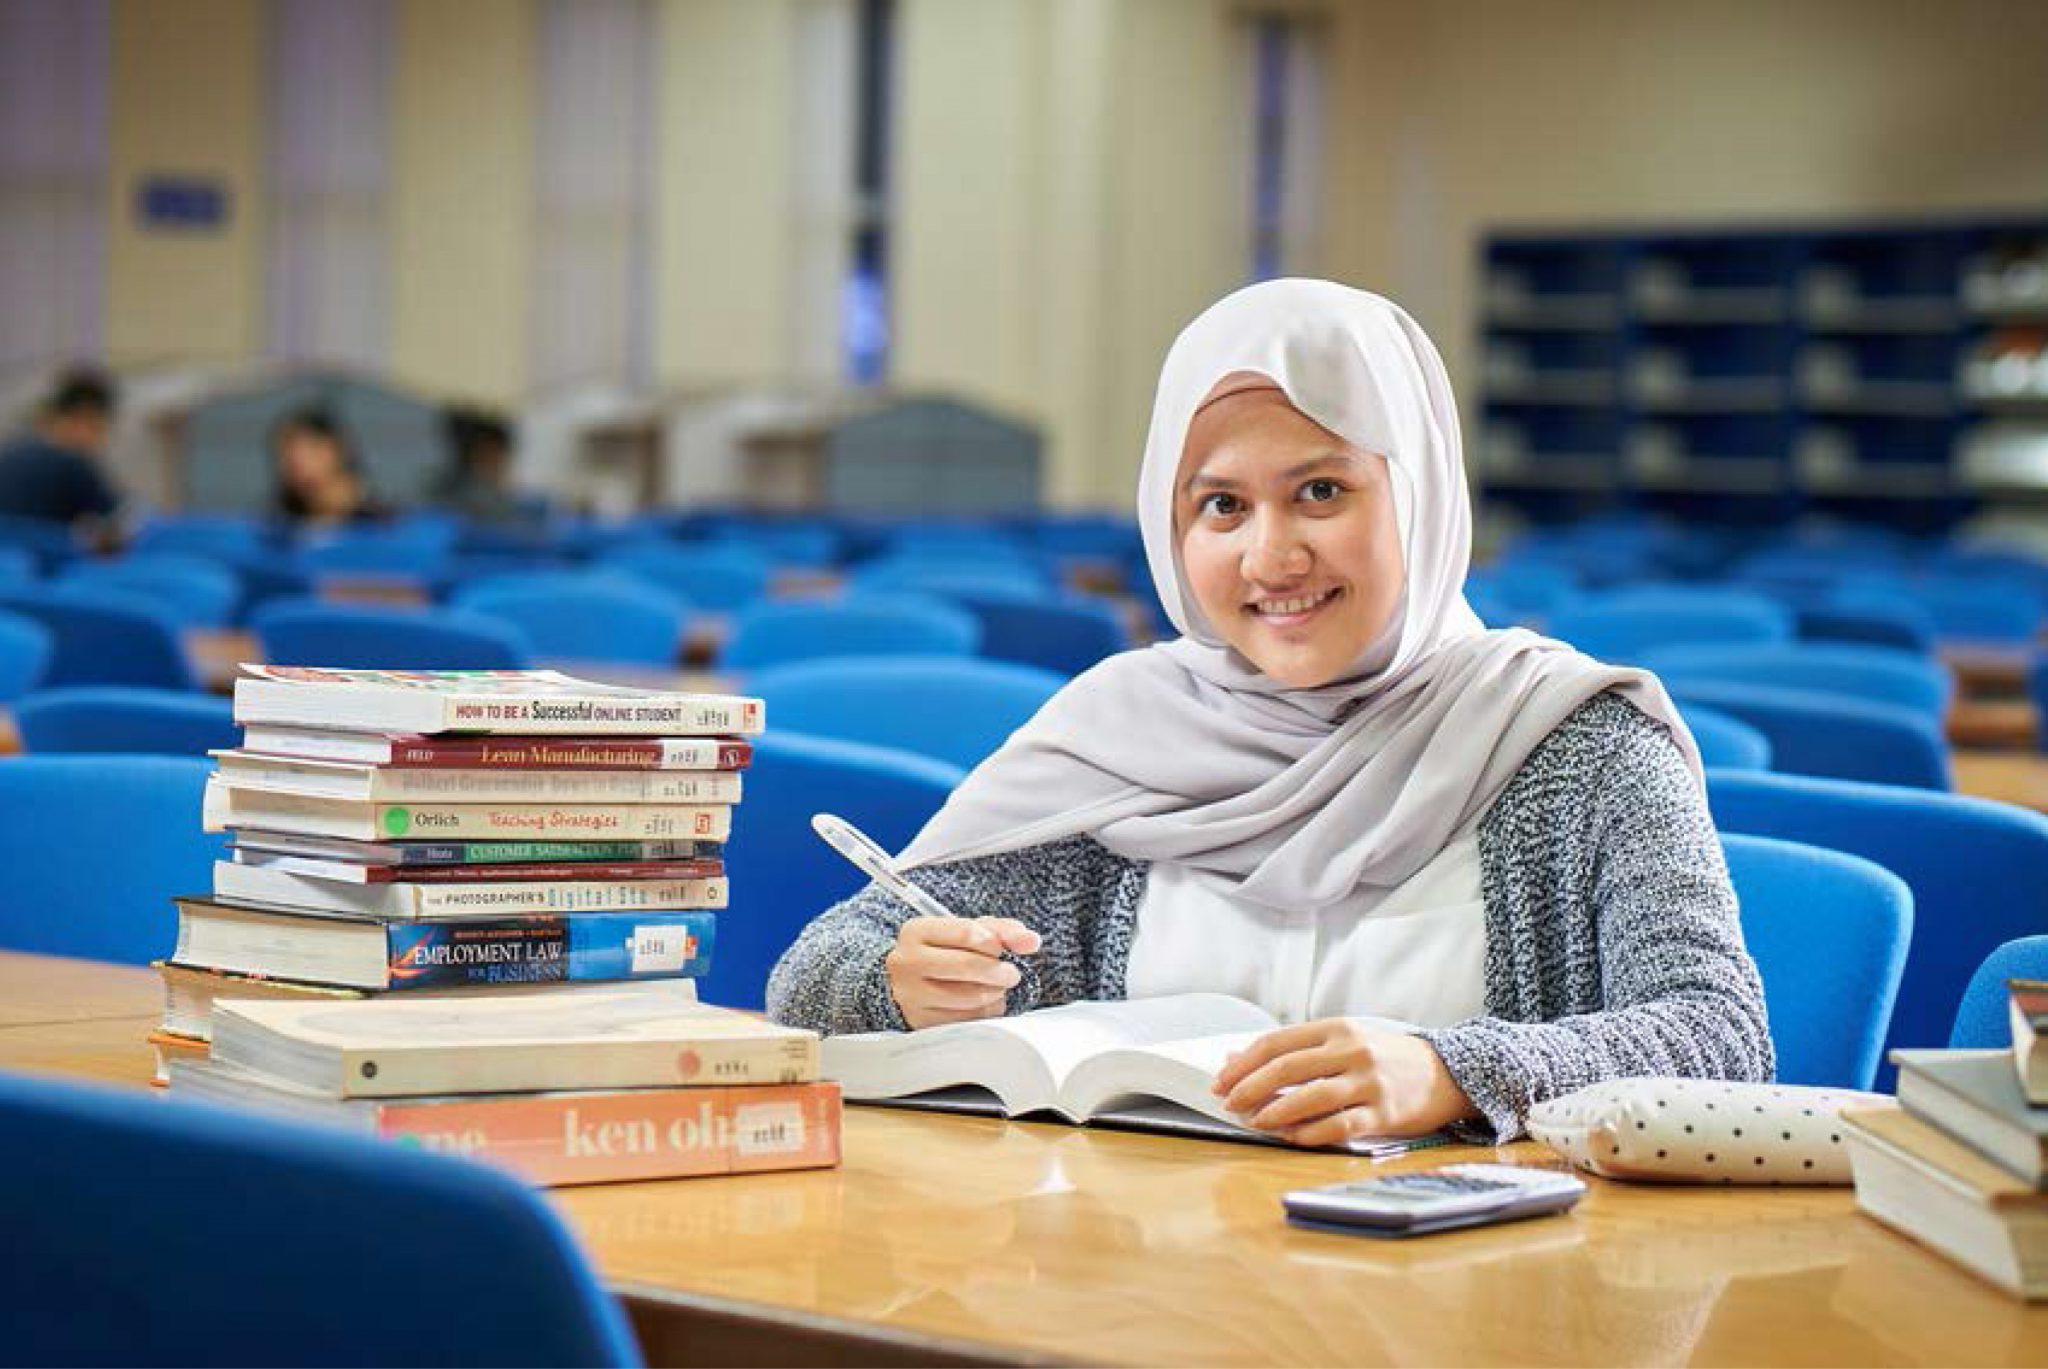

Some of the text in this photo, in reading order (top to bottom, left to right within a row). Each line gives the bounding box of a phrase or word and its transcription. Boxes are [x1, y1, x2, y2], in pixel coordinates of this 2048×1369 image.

[456, 705, 484, 719] HOW
[487, 706, 500, 719] TO
[504, 706, 519, 719] BE
[521, 706, 529, 719] A
[532, 701, 592, 721] Successful
[594, 707, 633, 721] ONLINE
[635, 708, 682, 721] STUDENT
[481, 744, 525, 764] Lean
[530, 745, 657, 769] Manufacturing
[415, 811, 460, 828] Orlich
[489, 810, 618, 830] Teaching Strategies
[414, 942, 562, 965] EMPLOYMENT LAW
[566, 1106, 658, 1158] ken
